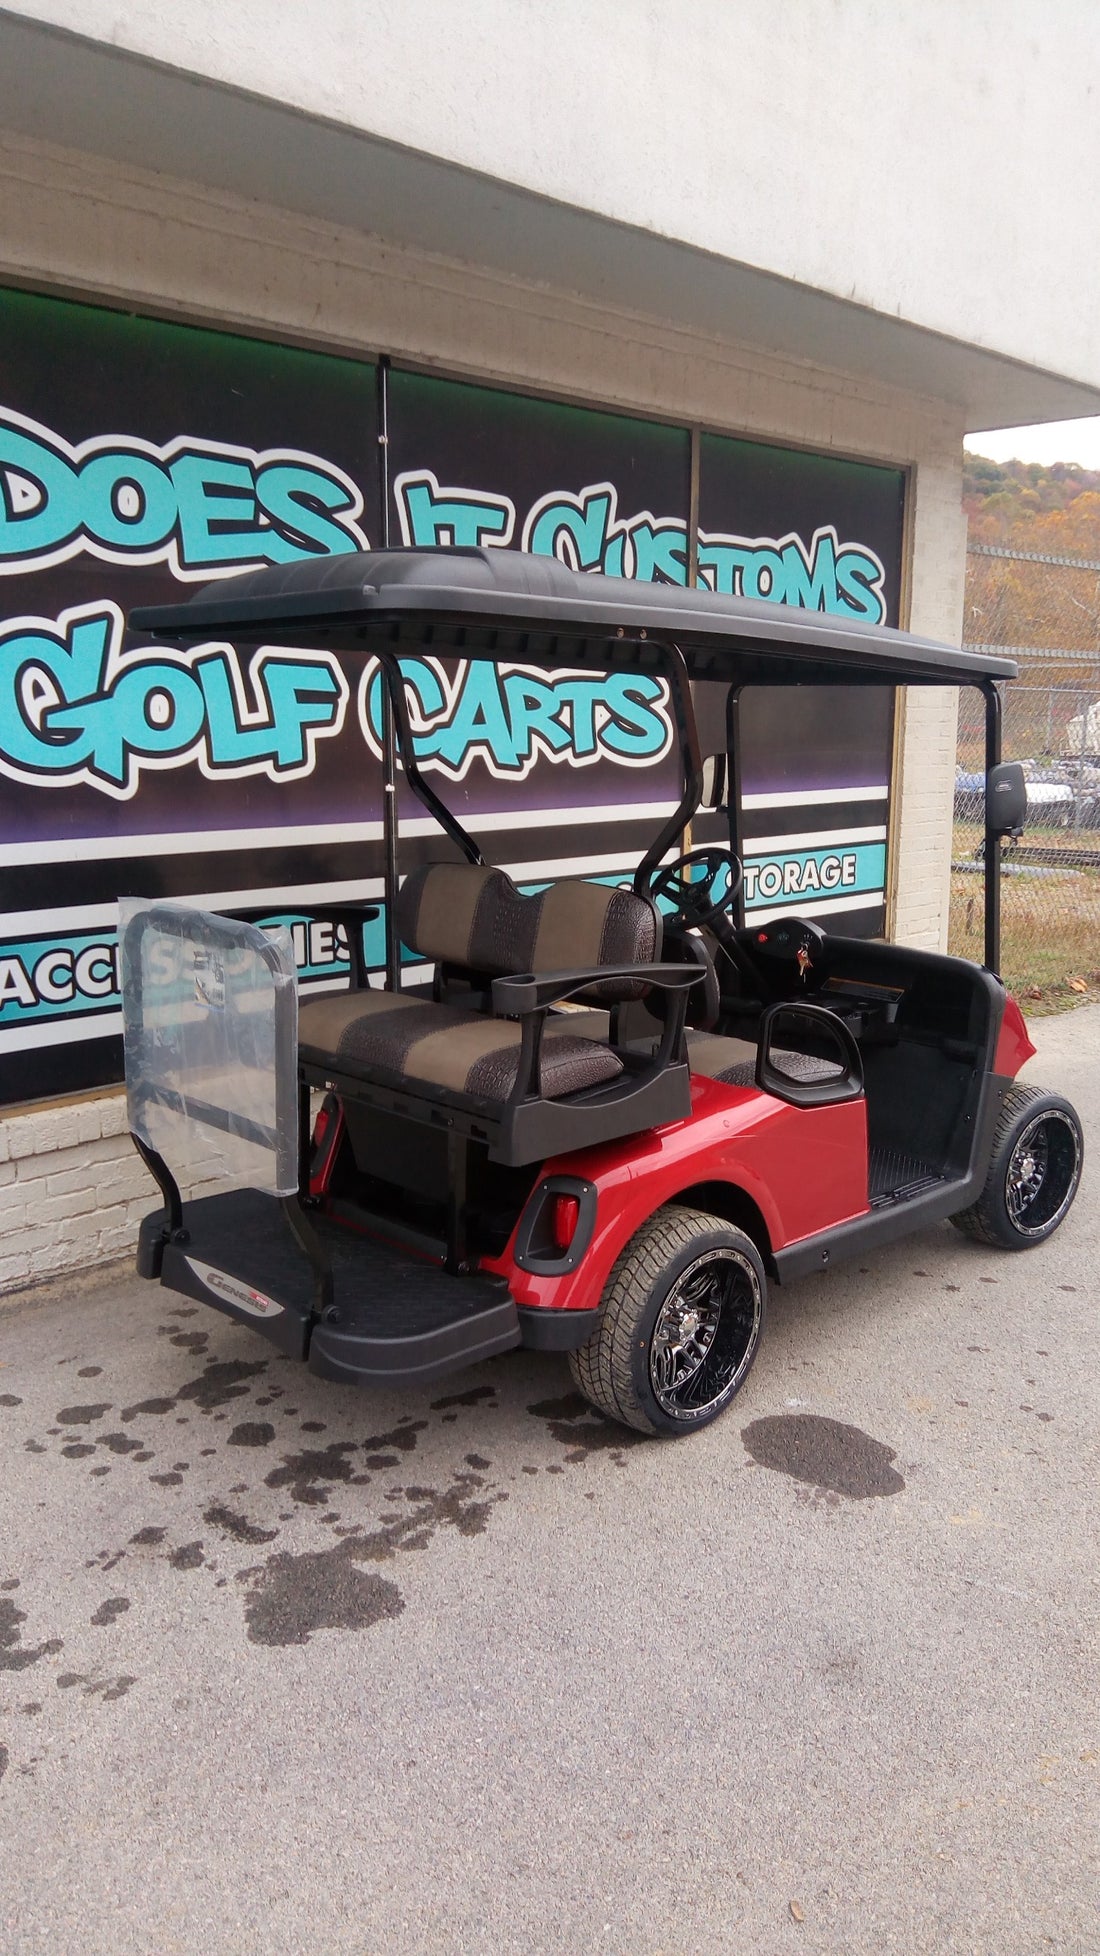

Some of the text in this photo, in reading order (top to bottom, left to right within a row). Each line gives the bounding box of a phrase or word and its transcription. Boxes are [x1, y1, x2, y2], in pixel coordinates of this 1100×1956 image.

[0, 413, 884, 625] DOES IT CUSTOMS
[0, 609, 670, 792] GOLF CARTS
[726, 853, 857, 899] TORAGE
